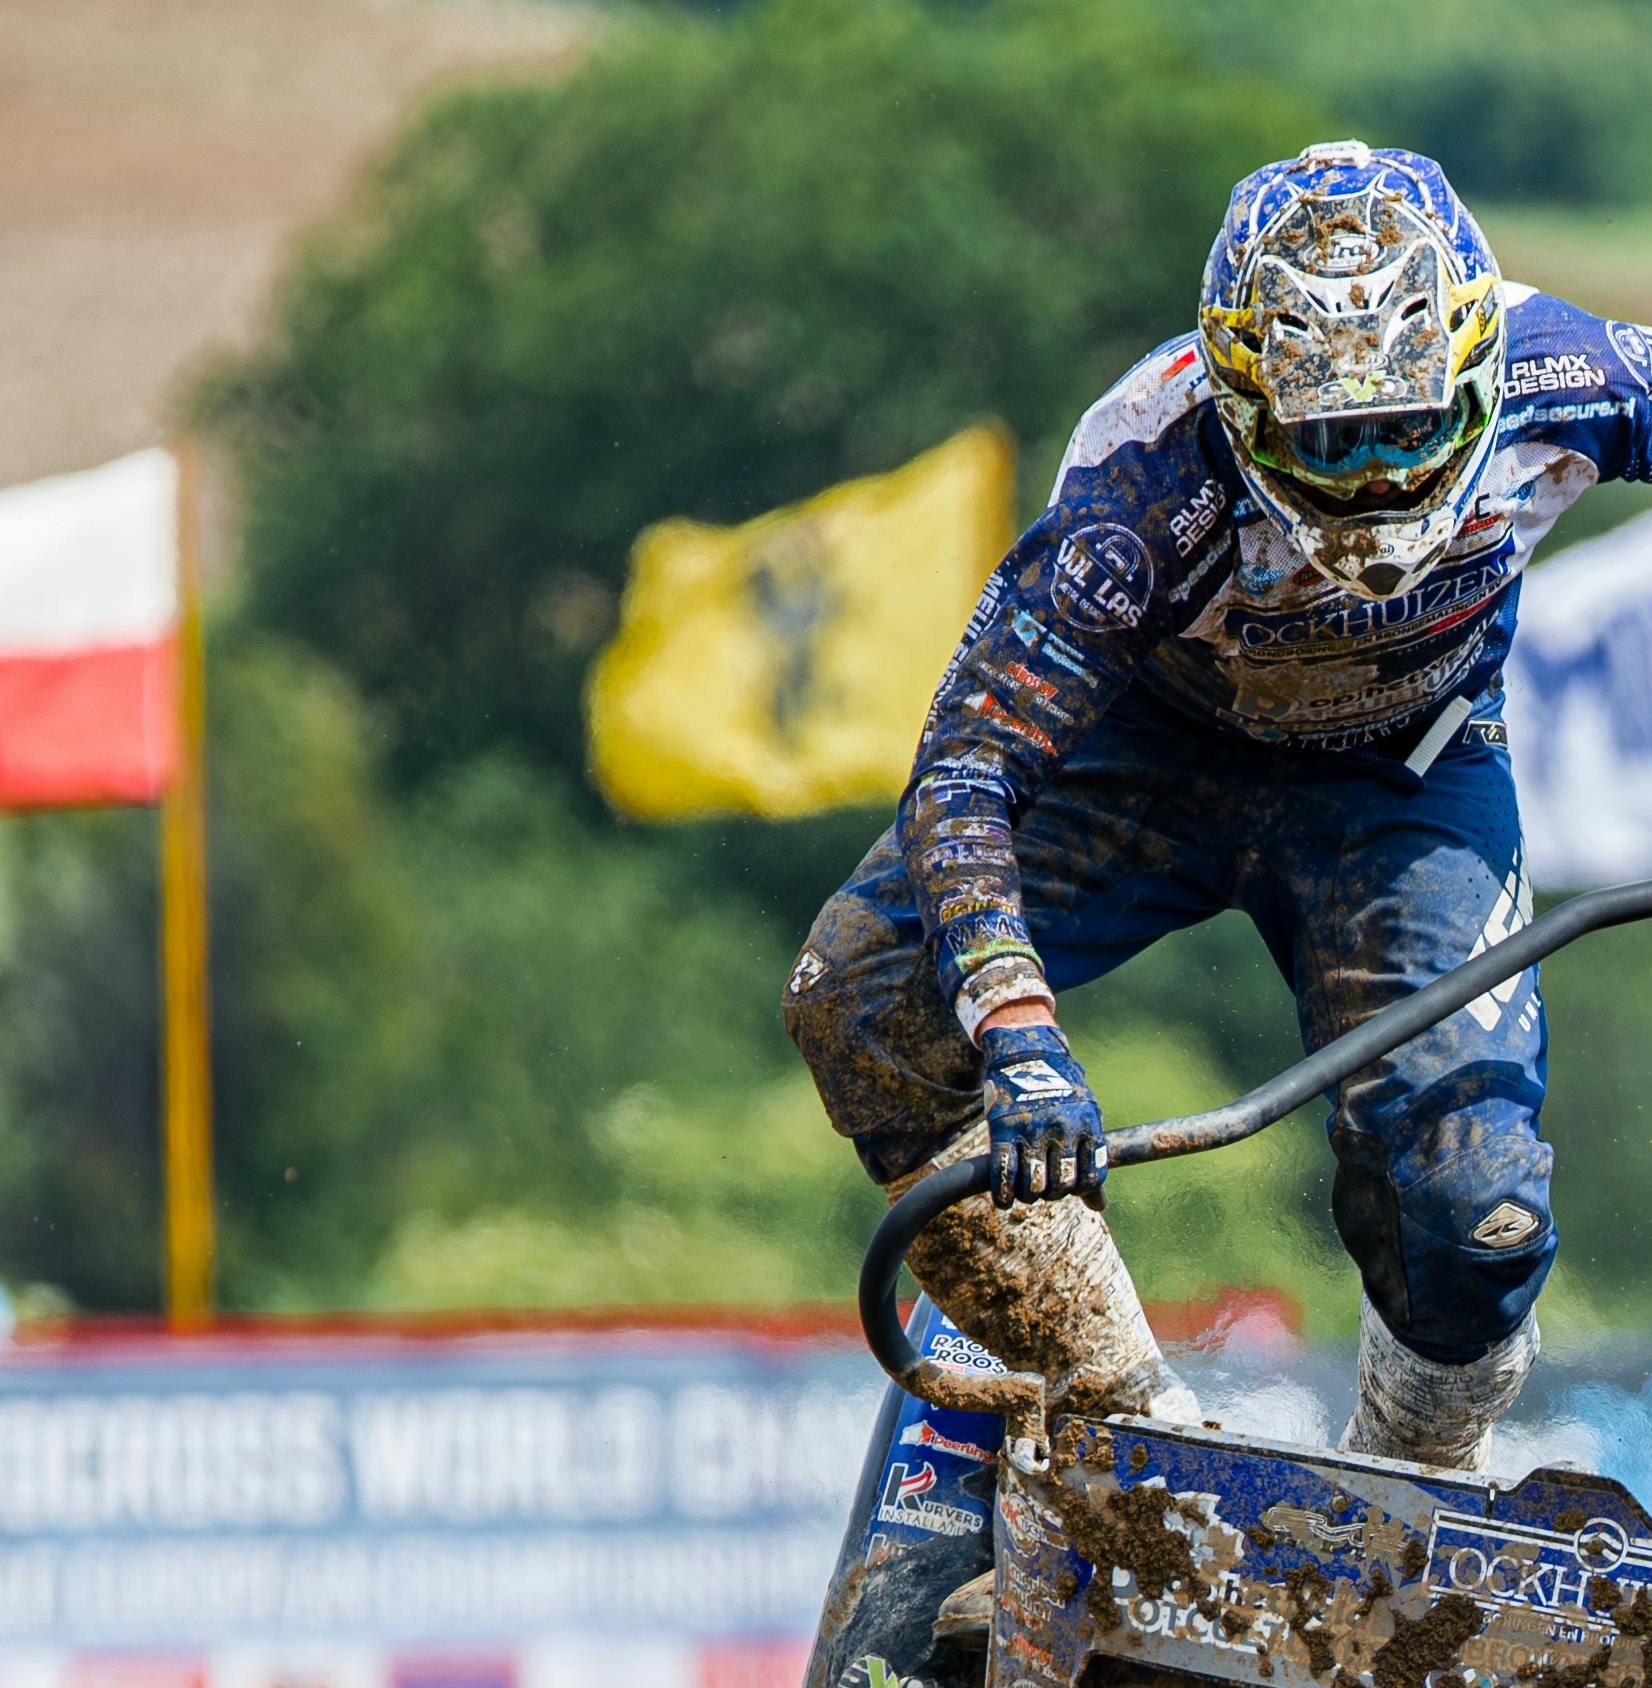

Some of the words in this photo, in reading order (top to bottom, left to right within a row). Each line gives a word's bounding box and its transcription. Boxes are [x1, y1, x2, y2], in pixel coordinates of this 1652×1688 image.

[1503, 368, 1606, 399] DESIGN
[1511, 353, 1591, 379] RLMX
[1057, 538, 1093, 588] VOL
[1093, 578, 1143, 628] LAS
[1241, 564, 1507, 648] OCKHUIZEN
